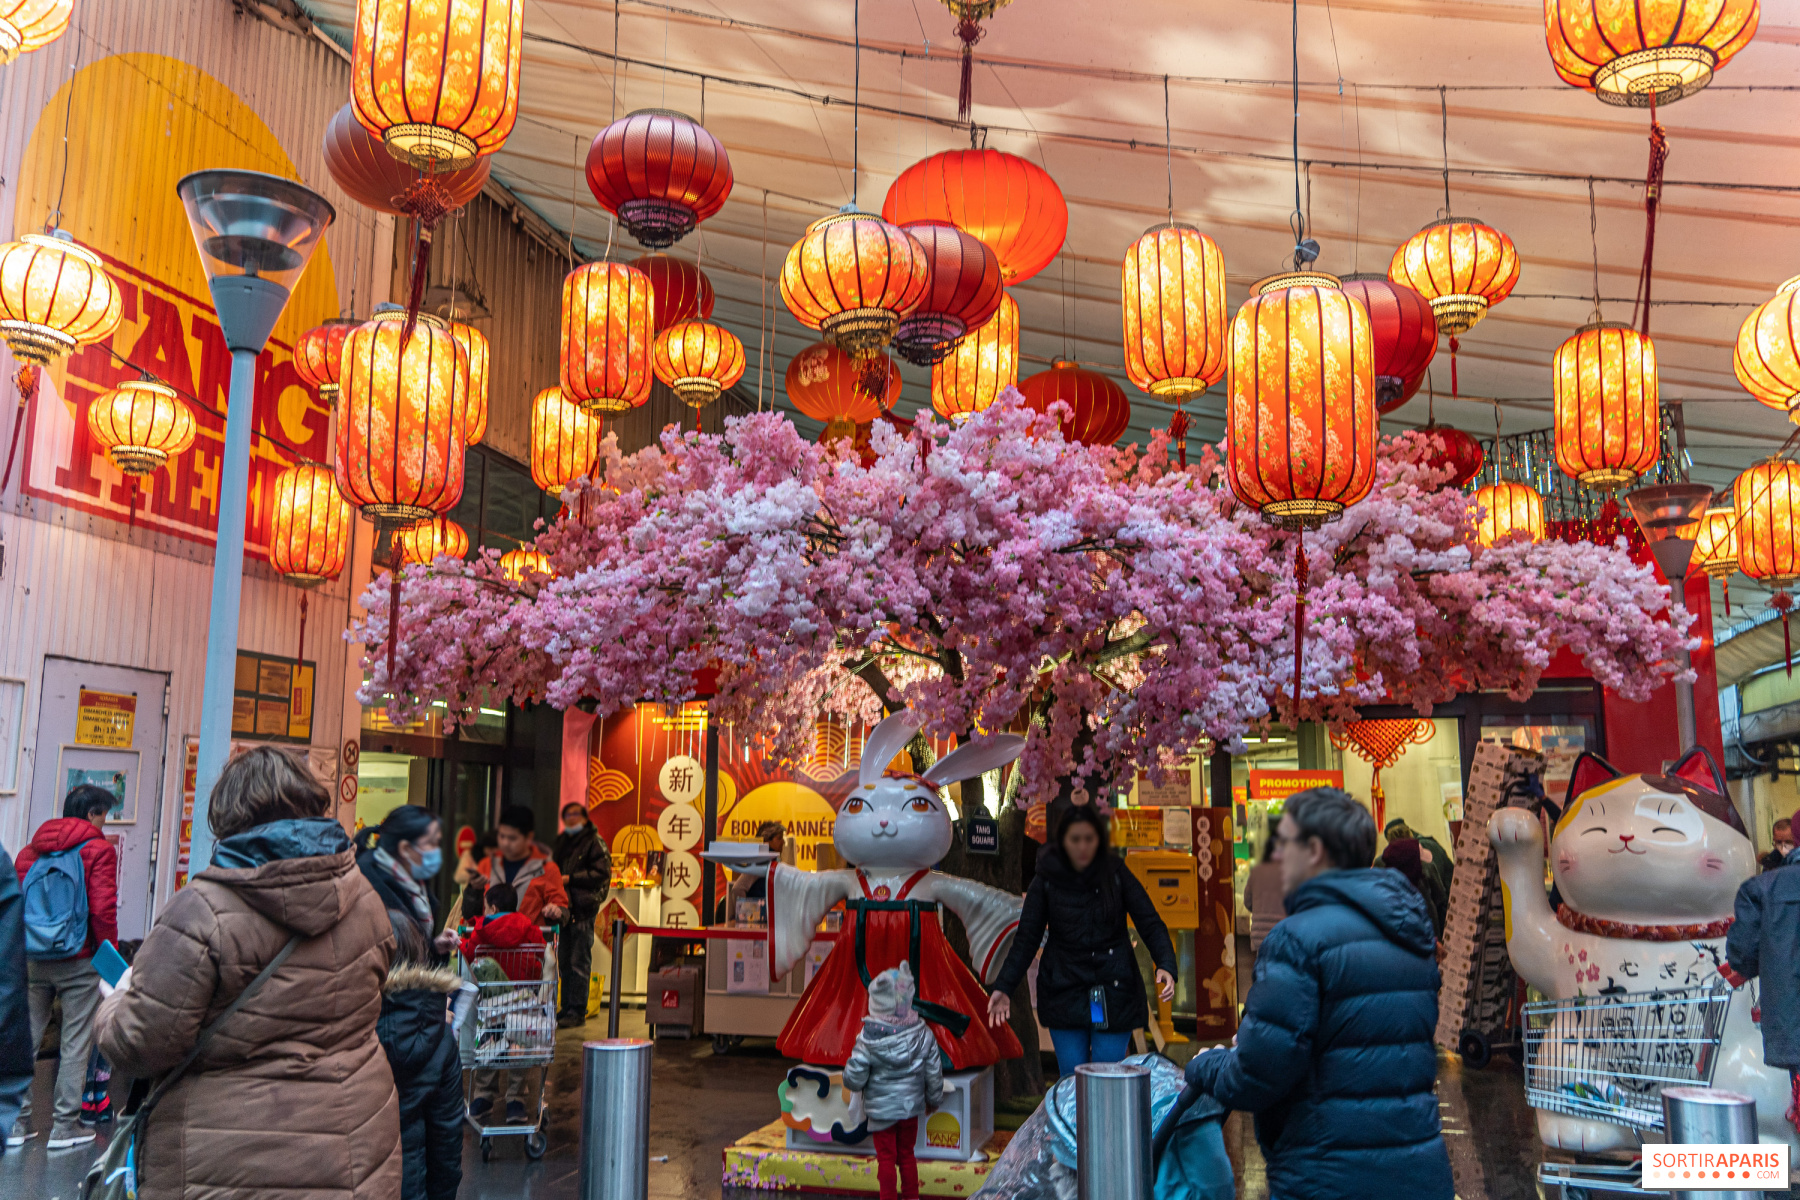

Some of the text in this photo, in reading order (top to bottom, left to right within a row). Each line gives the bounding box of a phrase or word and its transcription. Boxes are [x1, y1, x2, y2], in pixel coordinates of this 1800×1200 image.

[1259, 778, 1333, 789] PROMOTIONS
[731, 819, 783, 837] BON
[975, 824, 990, 835] TANG
[971, 835, 995, 846] SQUARE
[667, 766, 694, 929] 新年快乐
